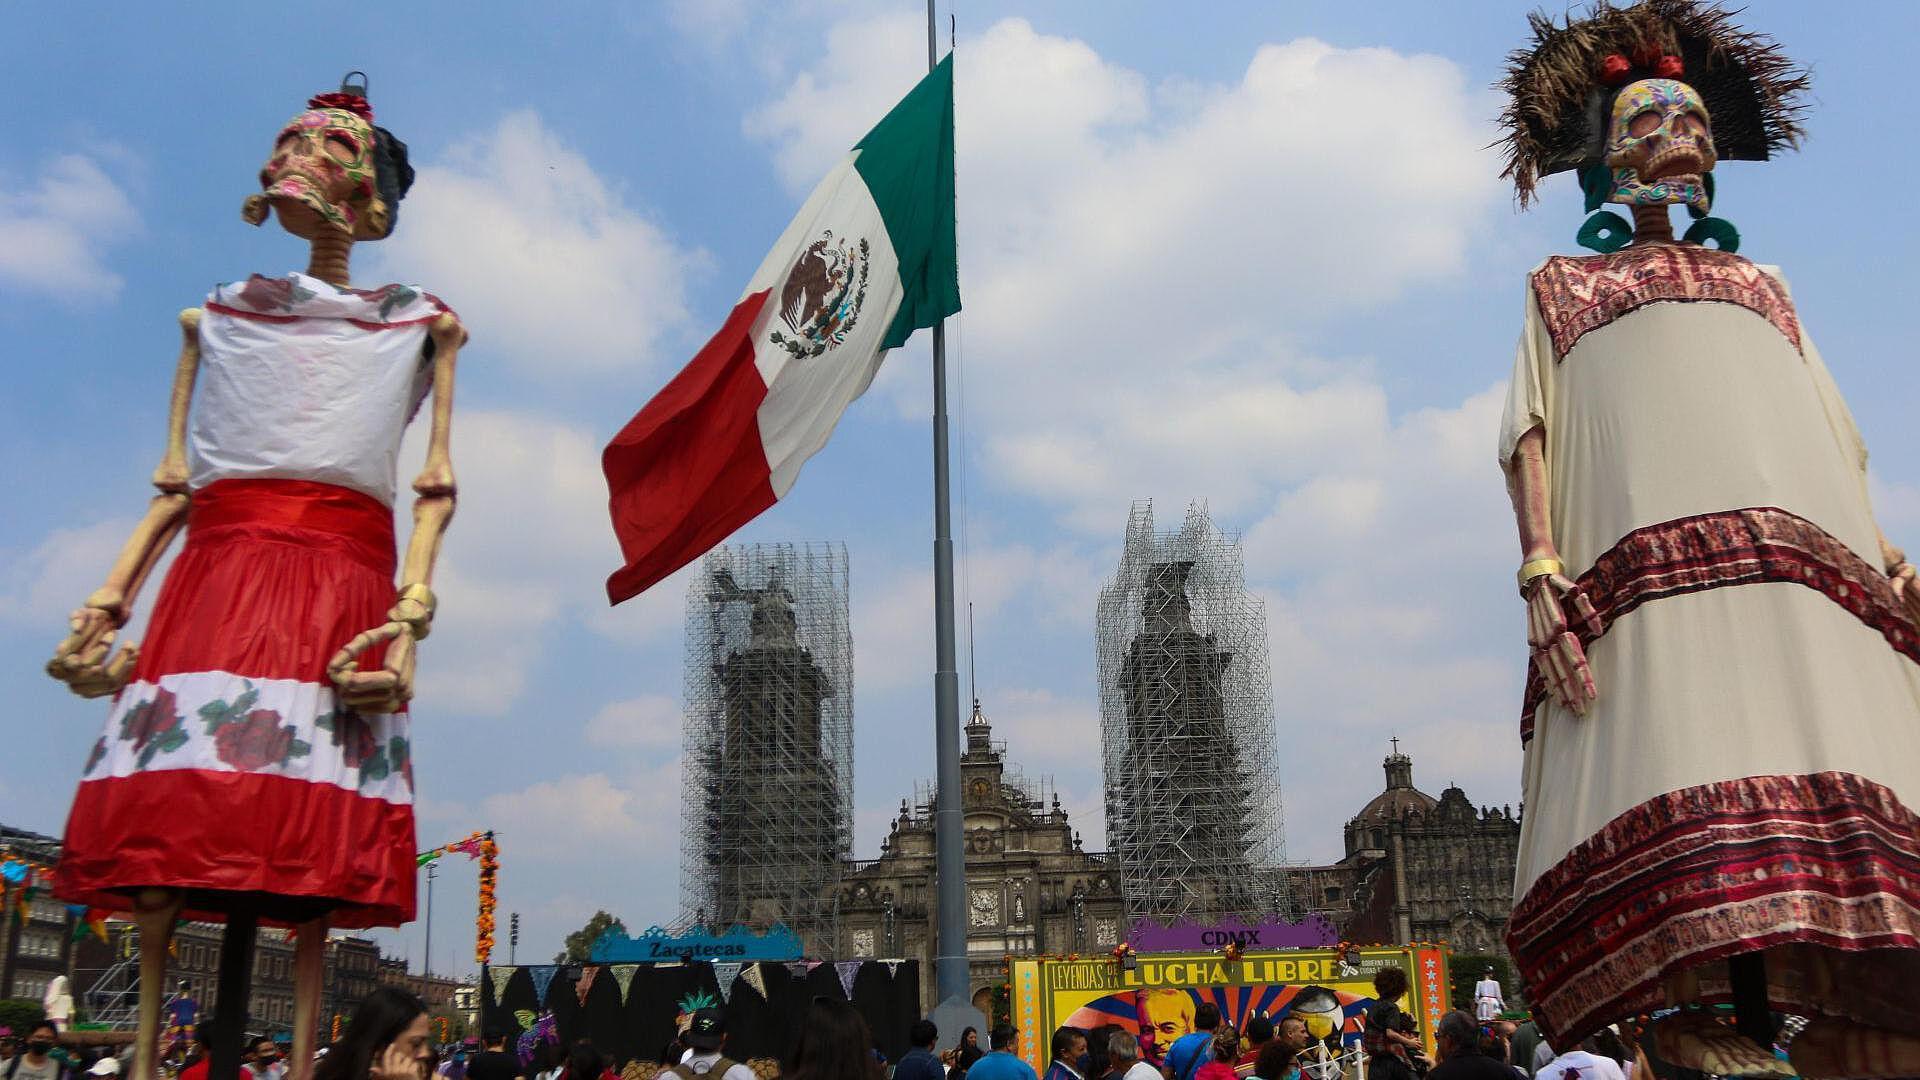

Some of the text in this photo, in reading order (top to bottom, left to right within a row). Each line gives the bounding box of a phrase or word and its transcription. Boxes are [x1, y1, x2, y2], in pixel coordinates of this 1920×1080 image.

[1201, 930, 1261, 946] CDMX
[651, 942, 746, 957] Zacatecas
[1052, 964, 1104, 989] LEYENDAS
[1107, 963, 1118, 976] DE
[1124, 960, 1339, 986] LUCHA LIBRE
[1107, 976, 1119, 988] LA
